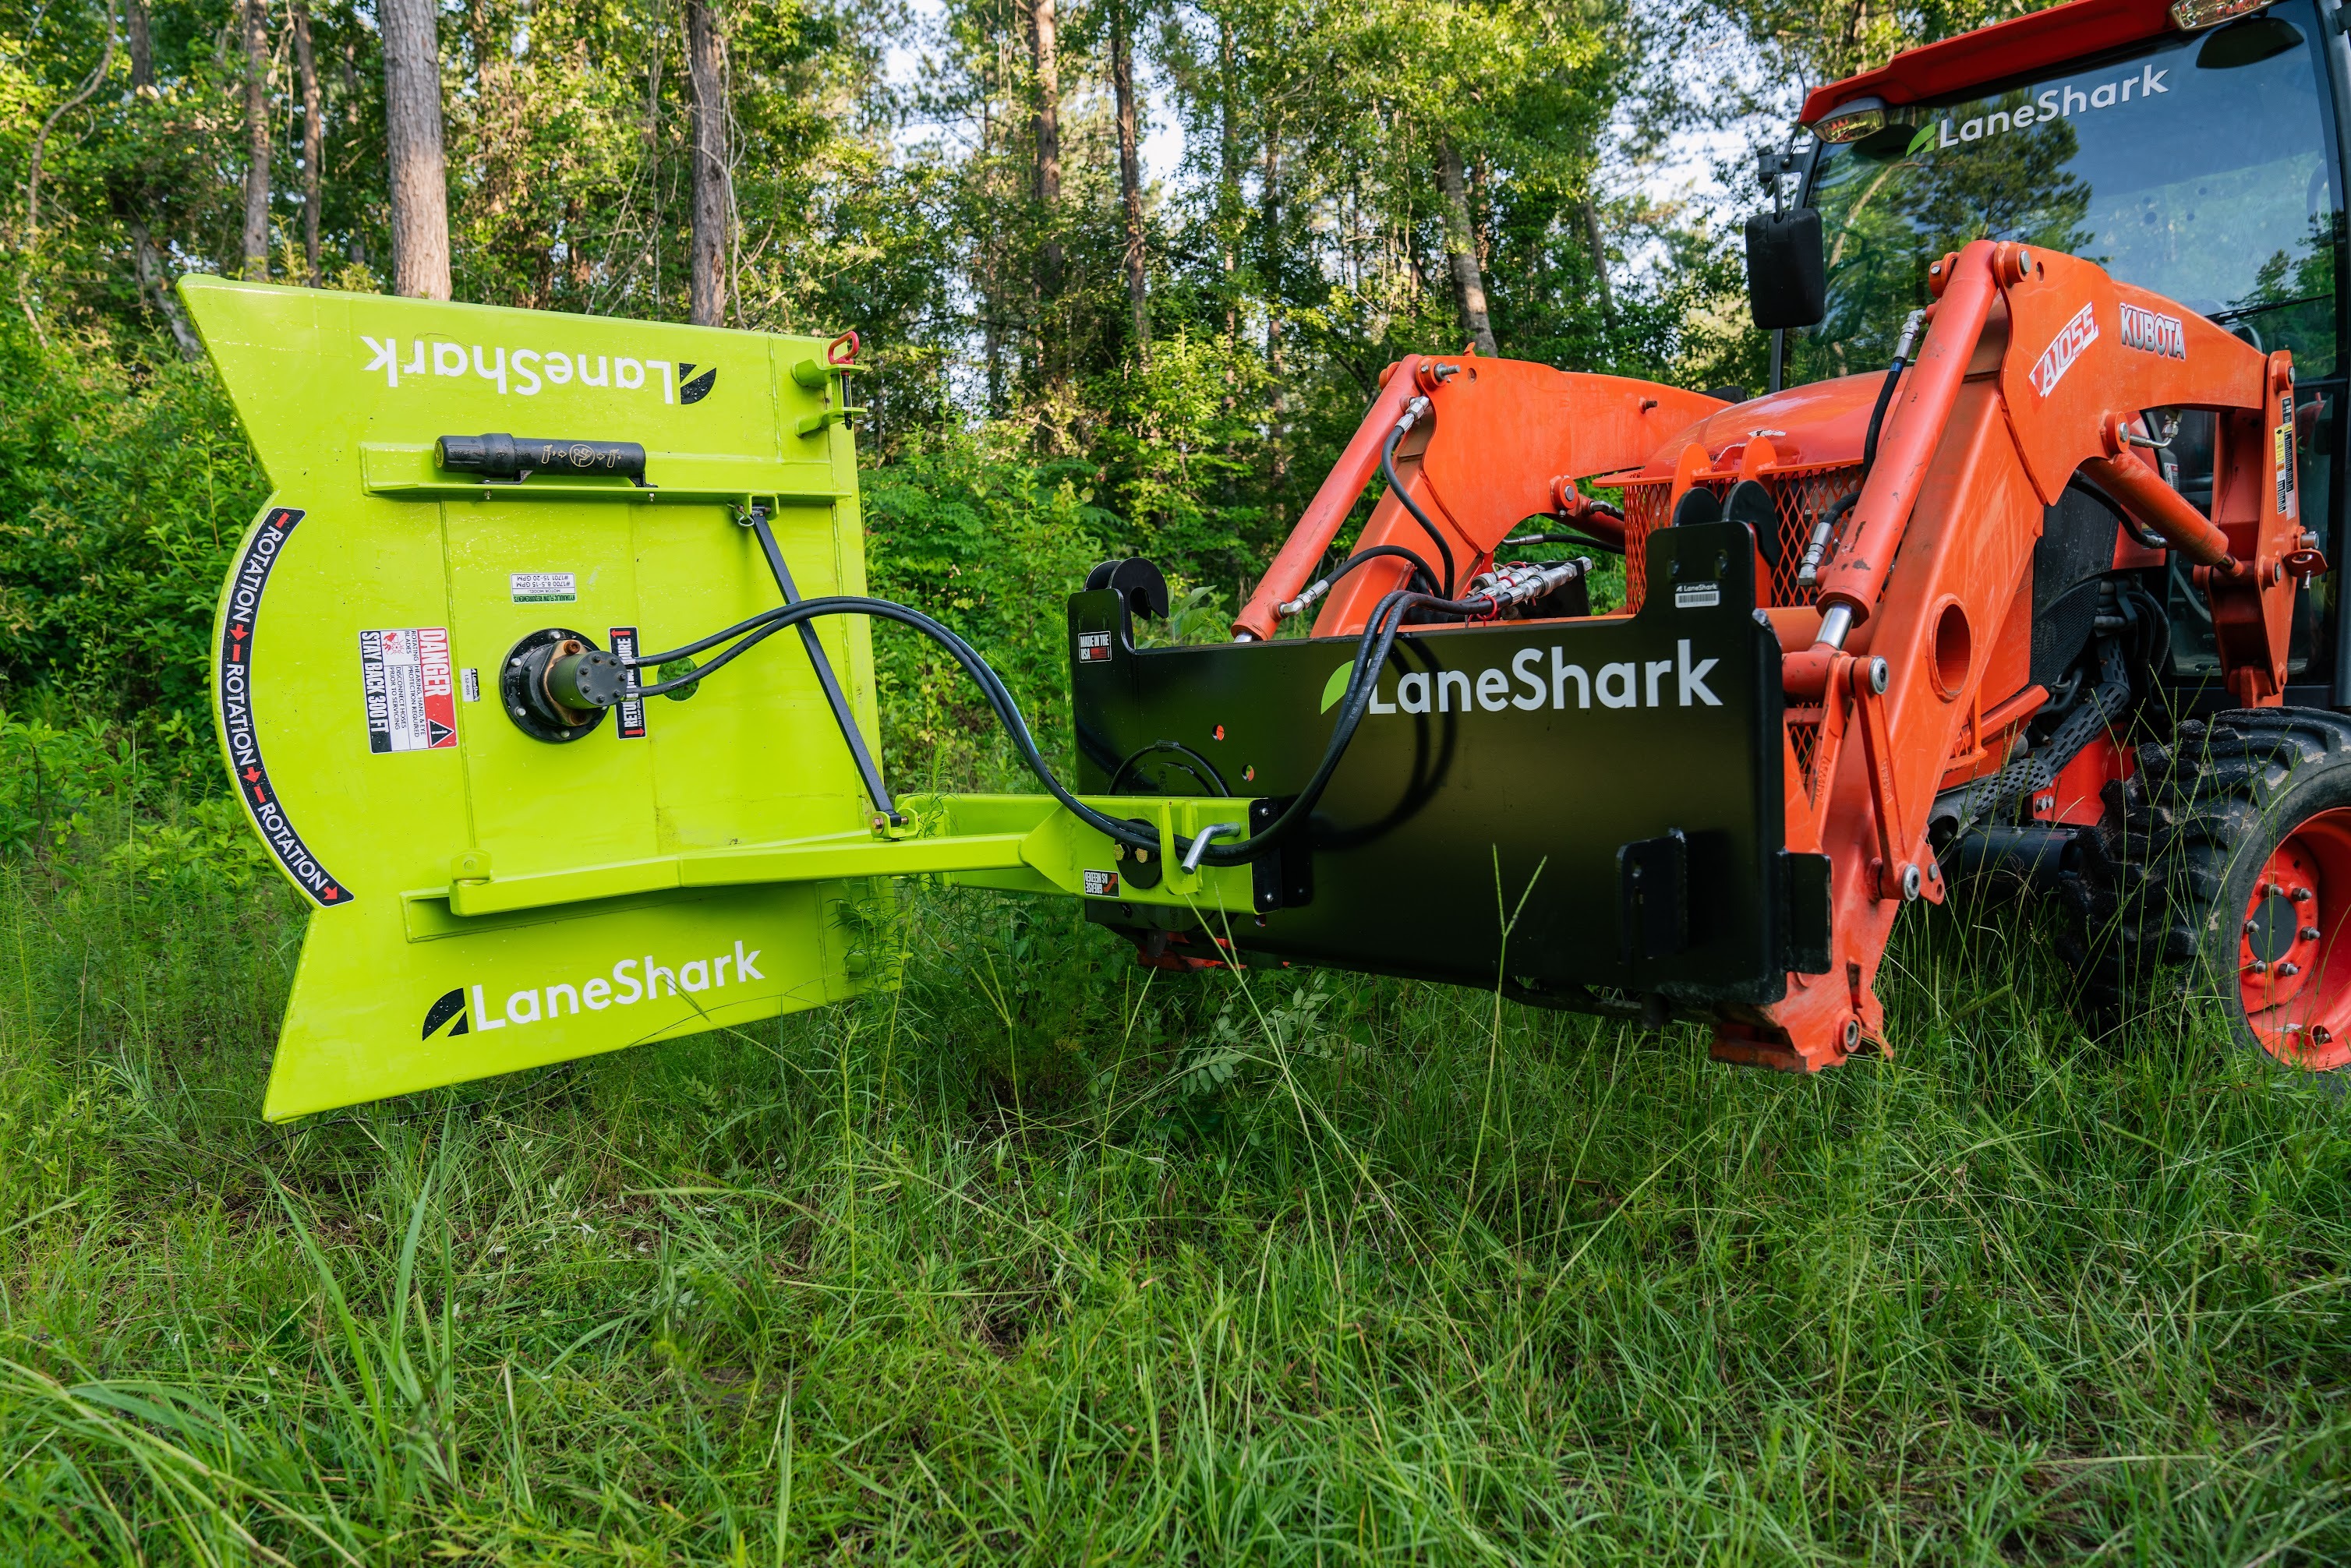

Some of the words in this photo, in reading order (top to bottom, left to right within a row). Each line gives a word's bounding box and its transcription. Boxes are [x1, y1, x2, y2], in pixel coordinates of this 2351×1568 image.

[1939, 64, 2169, 149] LaneShark
[2119, 302, 2186, 361] KUBOTA
[2031, 305, 2096, 396] A1055
[360, 336, 674, 404] LaneShark
[233, 525, 284, 622] ROTATION
[1684, 583, 1717, 592] LaneShark
[362, 632, 382, 662] STAY
[1080, 635, 1094, 648] MADE
[1094, 634, 1100, 647] IN
[1100, 634, 1109, 646] THE
[1080, 648, 1091, 660] USA
[365, 662, 385, 694] BACK
[419, 629, 451, 697] DANGER
[1368, 639, 1723, 715] LaneShark
[391, 687, 397, 696] TO
[396, 666, 405, 707] DISCONNECT
[408, 666, 416, 705] PROTECTION
[227, 664, 256, 765] ROTATION
[368, 695, 388, 718] 300
[621, 693, 639, 728] RETU
[369, 719, 389, 733] FT
[258, 802, 328, 891] ROTATION
[1085, 871, 1101, 883] NEEDED
[1086, 882, 1103, 894] GREASE
[1101, 872, 1108, 884] AS
[472, 940, 765, 1032] LaneShark
